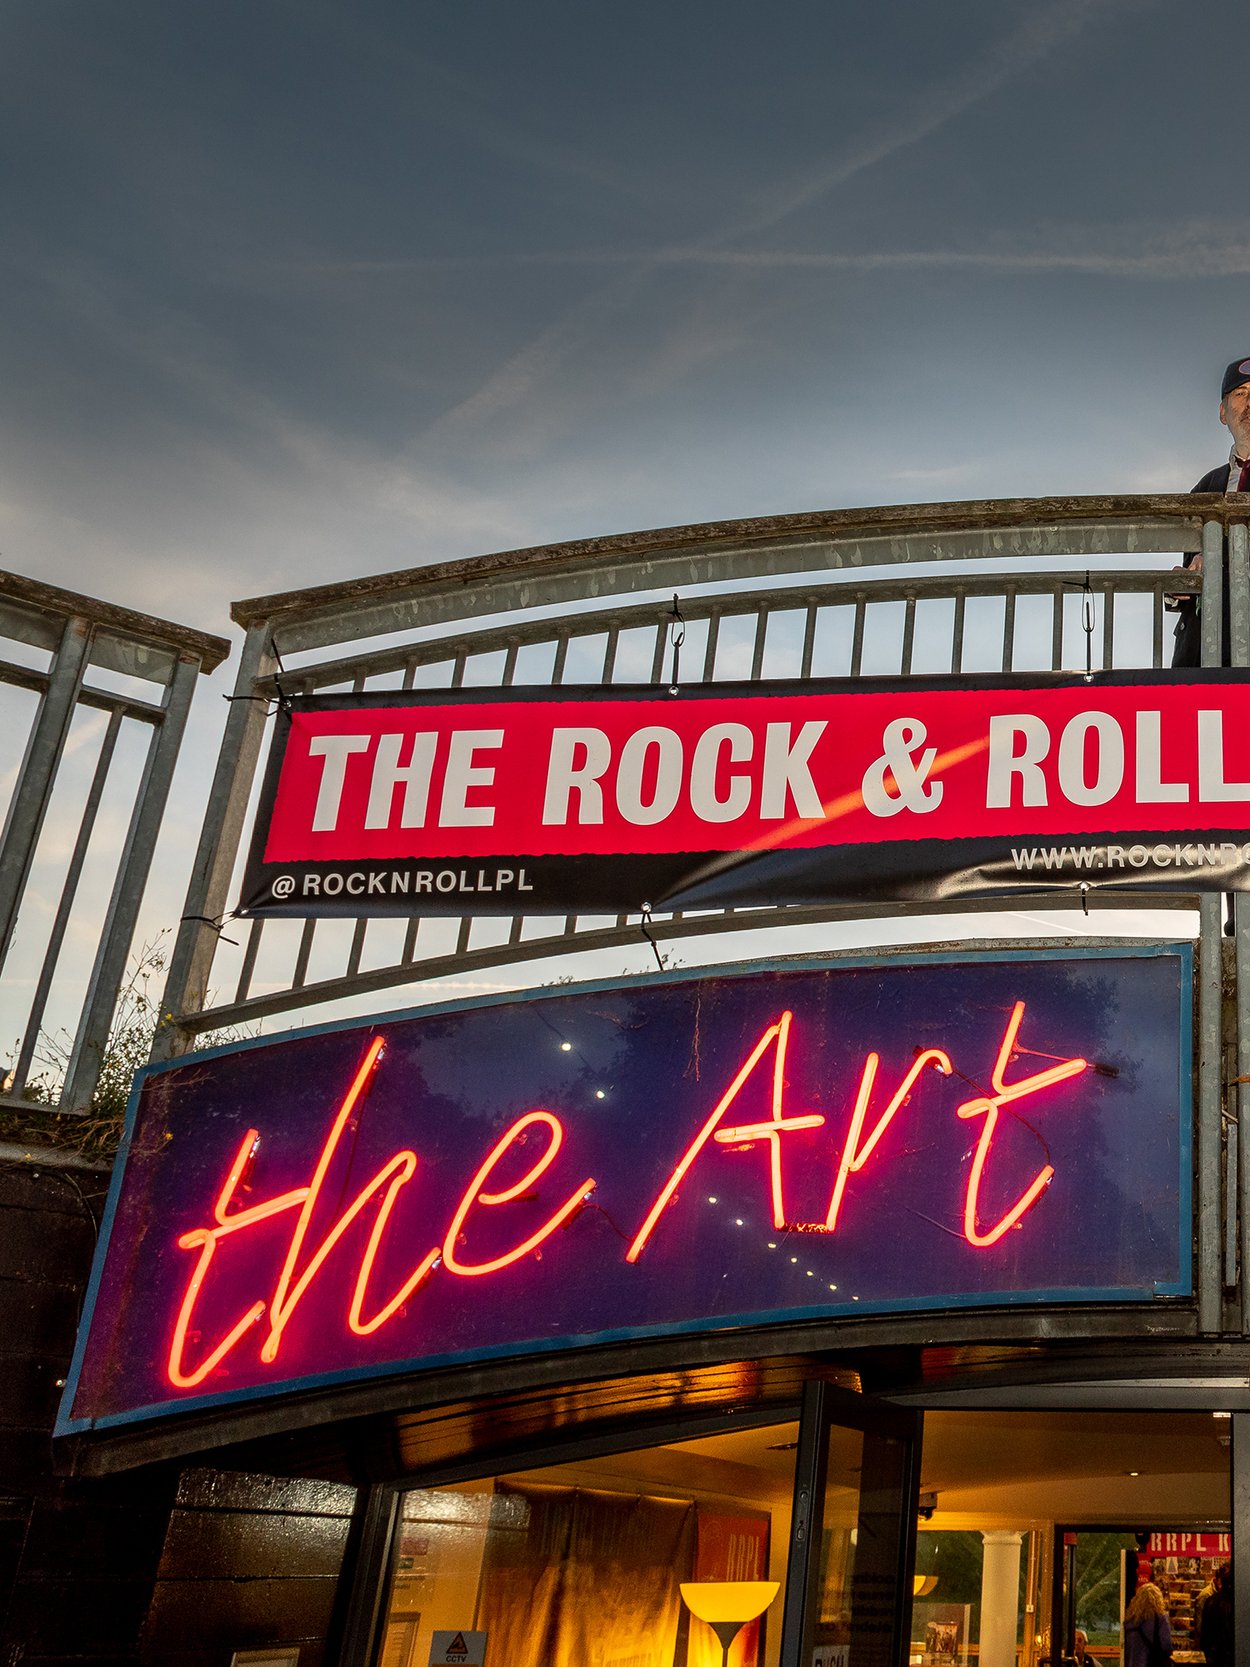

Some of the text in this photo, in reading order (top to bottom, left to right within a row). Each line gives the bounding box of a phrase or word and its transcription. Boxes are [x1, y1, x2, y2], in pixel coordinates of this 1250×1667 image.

[307, 729, 505, 833] THE
[541, 720, 830, 826] ROCK
[861, 716, 944, 818] &
[271, 868, 534, 900] @ROCKNROLLPL
[167, 1035, 598, 1388] the
[625, 1000, 1088, 1248] Art
[445, 1655, 467, 1663] CCTV
